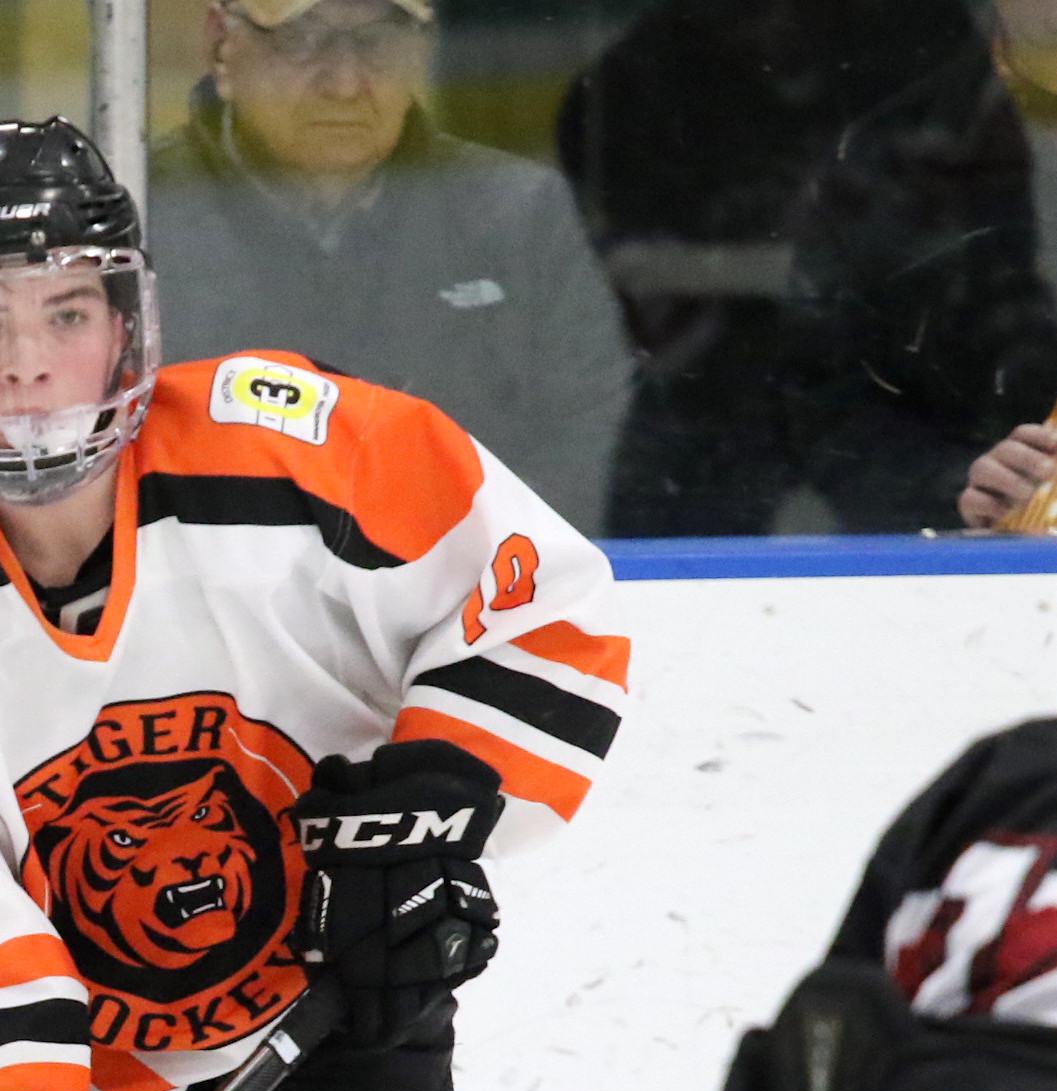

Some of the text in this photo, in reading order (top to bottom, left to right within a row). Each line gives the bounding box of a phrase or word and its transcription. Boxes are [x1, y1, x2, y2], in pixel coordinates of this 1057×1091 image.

[250, 378, 301, 404] 3
[462, 532, 539, 646] 10
[23, 706, 227, 808] TIGER
[299, 808, 475, 851] CCM
[90, 938, 306, 1052] OCKEY
